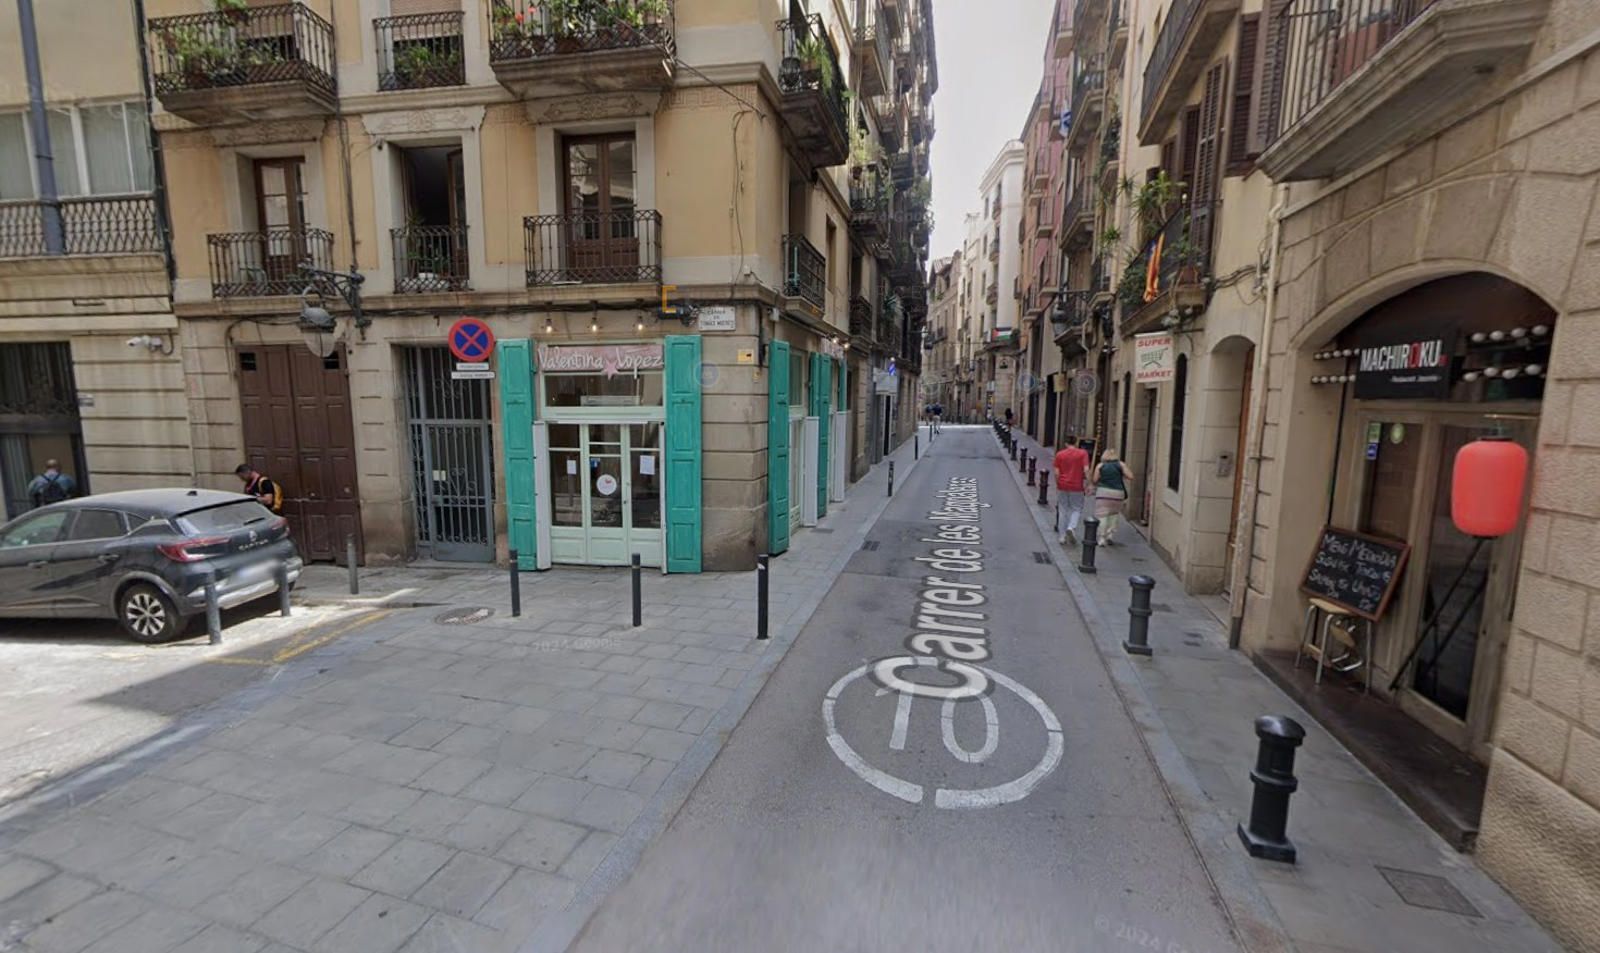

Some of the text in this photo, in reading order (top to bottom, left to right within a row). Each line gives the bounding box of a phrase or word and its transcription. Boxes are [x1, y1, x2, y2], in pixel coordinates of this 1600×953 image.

[1137, 338, 1171, 347] SUPER
[538, 346, 604, 369] Valentina
[1137, 370, 1172, 379] MARKET
